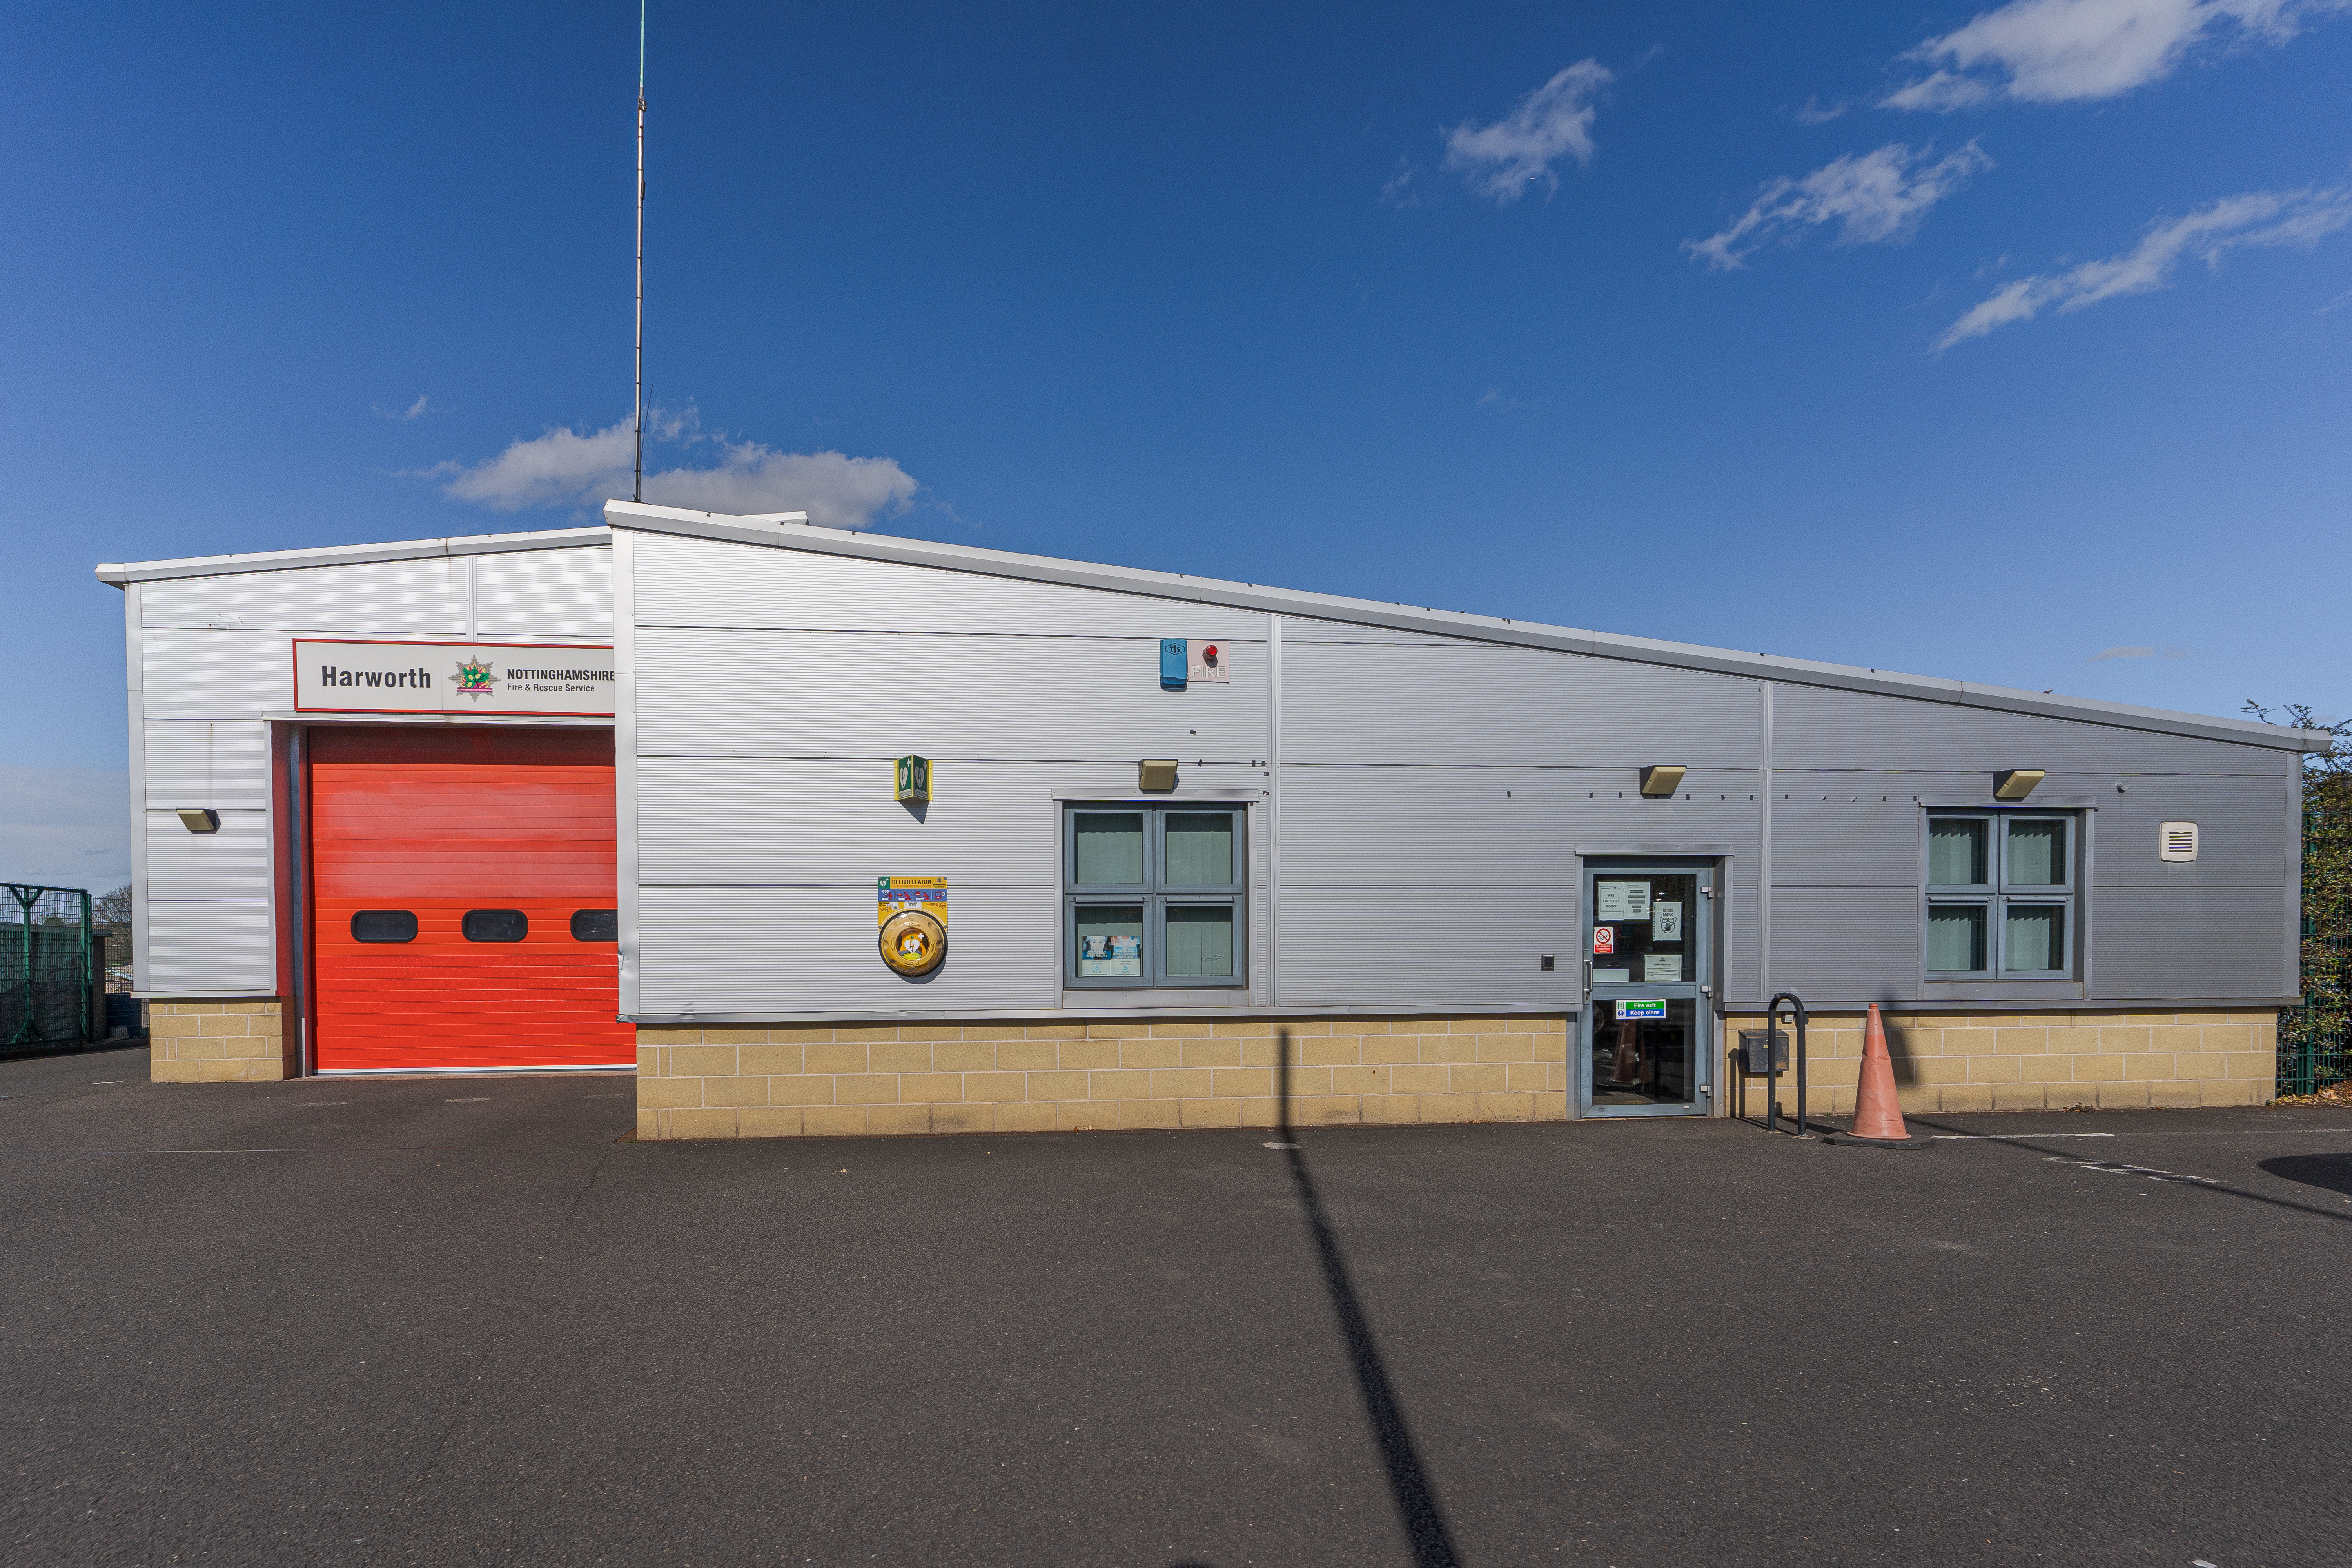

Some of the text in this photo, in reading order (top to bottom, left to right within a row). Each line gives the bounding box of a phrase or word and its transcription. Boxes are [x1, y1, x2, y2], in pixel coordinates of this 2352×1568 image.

[321, 666, 431, 688] Harworth
[507, 669, 615, 681] NOTTINGHAMSHIRE
[1192, 665, 1226, 678] FIRE
[915, 789, 927, 797] Defibrillator
